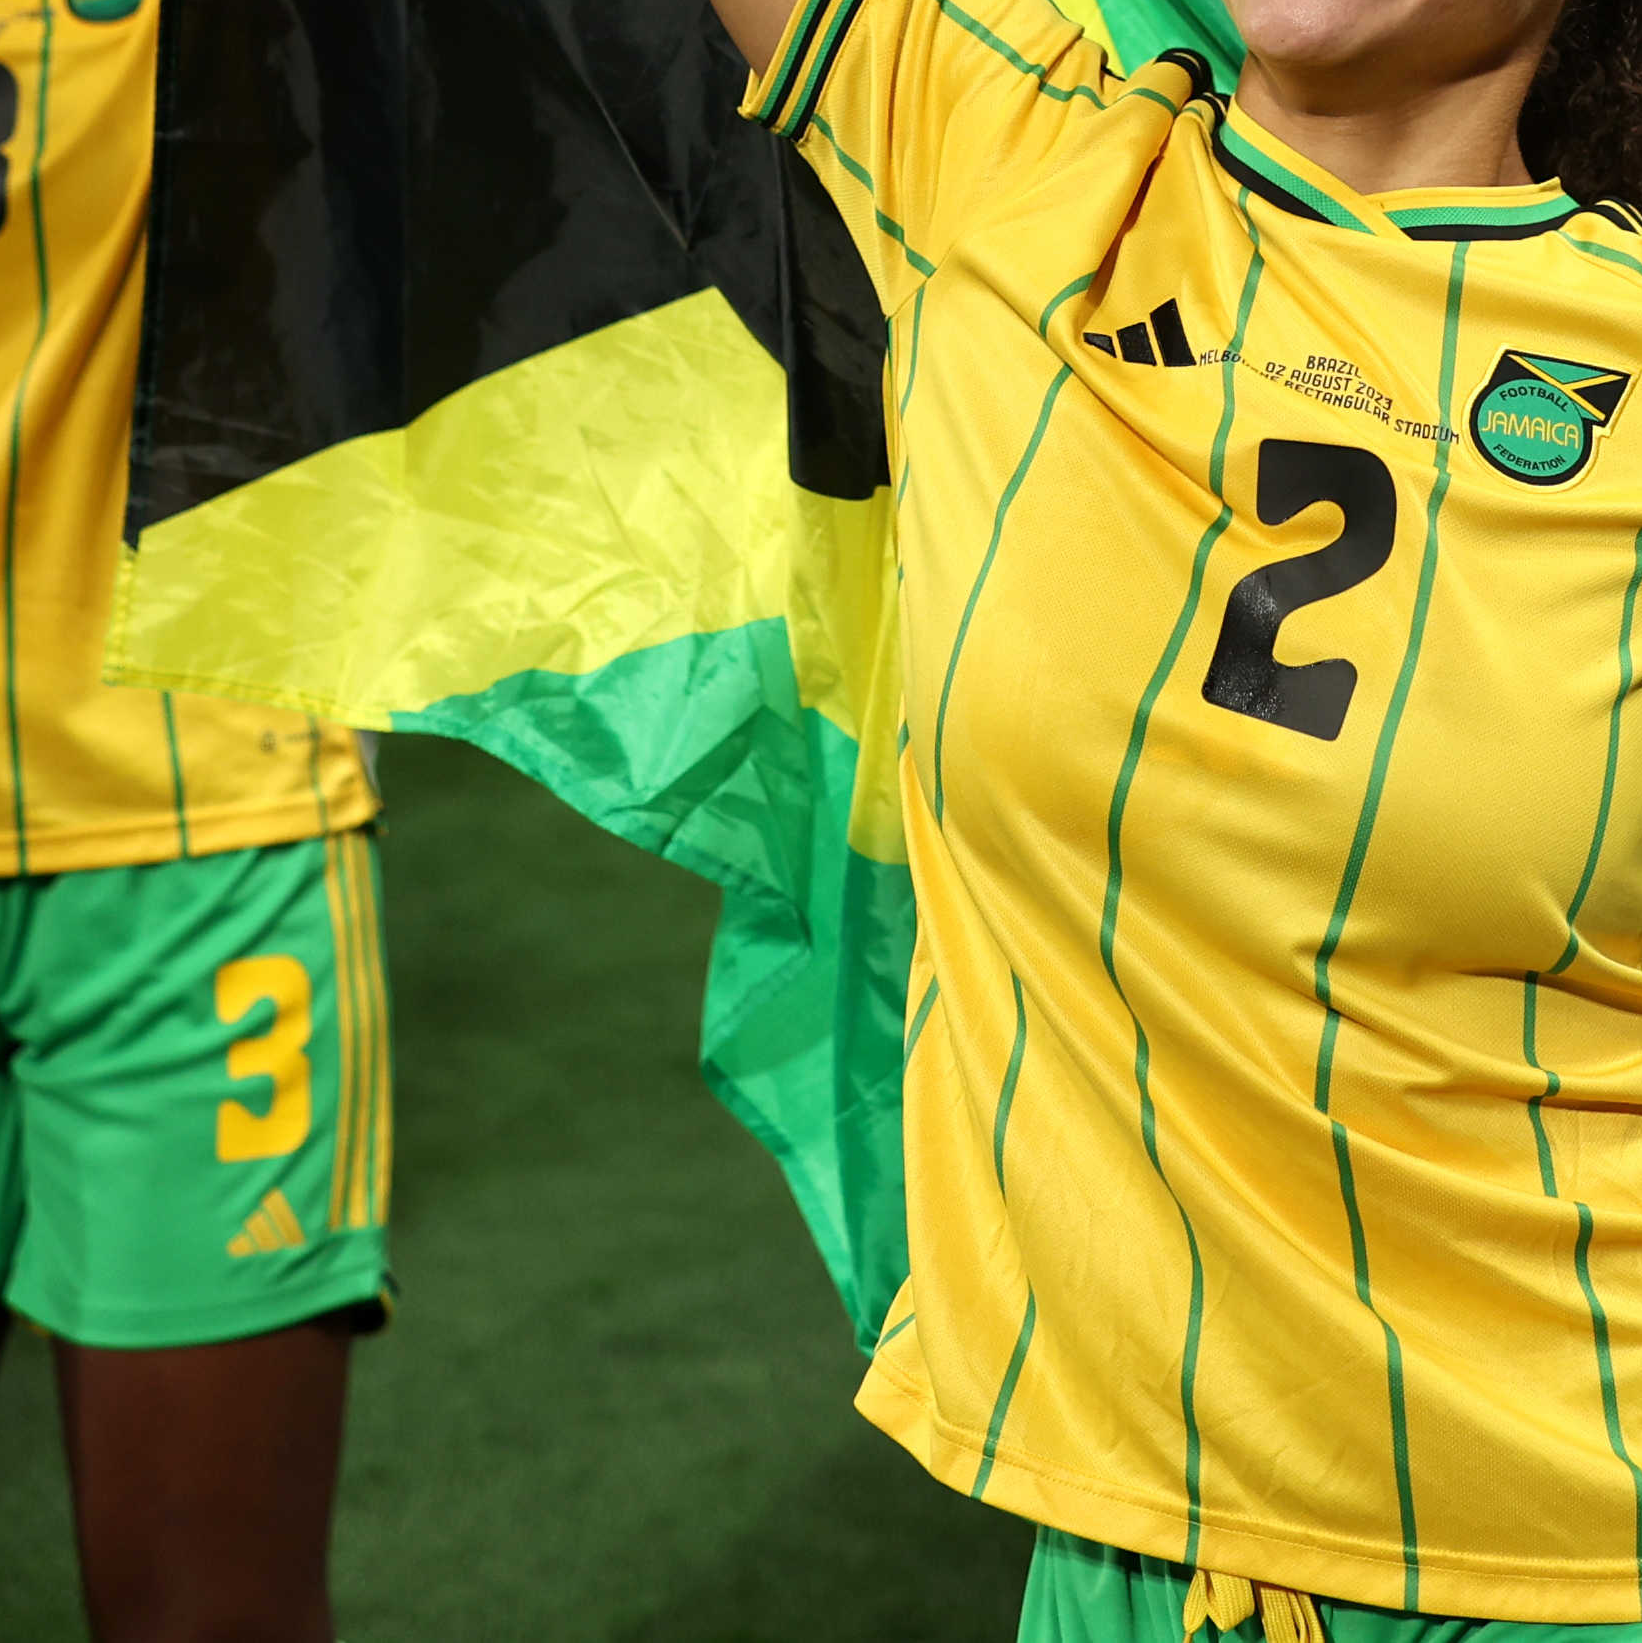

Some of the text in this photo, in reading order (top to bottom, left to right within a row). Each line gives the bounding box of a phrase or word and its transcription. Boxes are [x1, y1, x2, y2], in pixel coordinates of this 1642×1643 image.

[1265, 361, 1394, 412] 02 AUGUST 2023
[1306, 355, 1363, 379] BRAZIL
[1285, 380, 1391, 426] RECTANGULAR
[1393, 419, 1460, 445] STADIUM
[1499, 386, 1573, 413] FOOTBALL
[1481, 410, 1579, 450] JAMAICA
[1493, 443, 1566, 471] FEDERATION
[1201, 438, 1397, 741] 2
[214, 955, 312, 1163] 3
